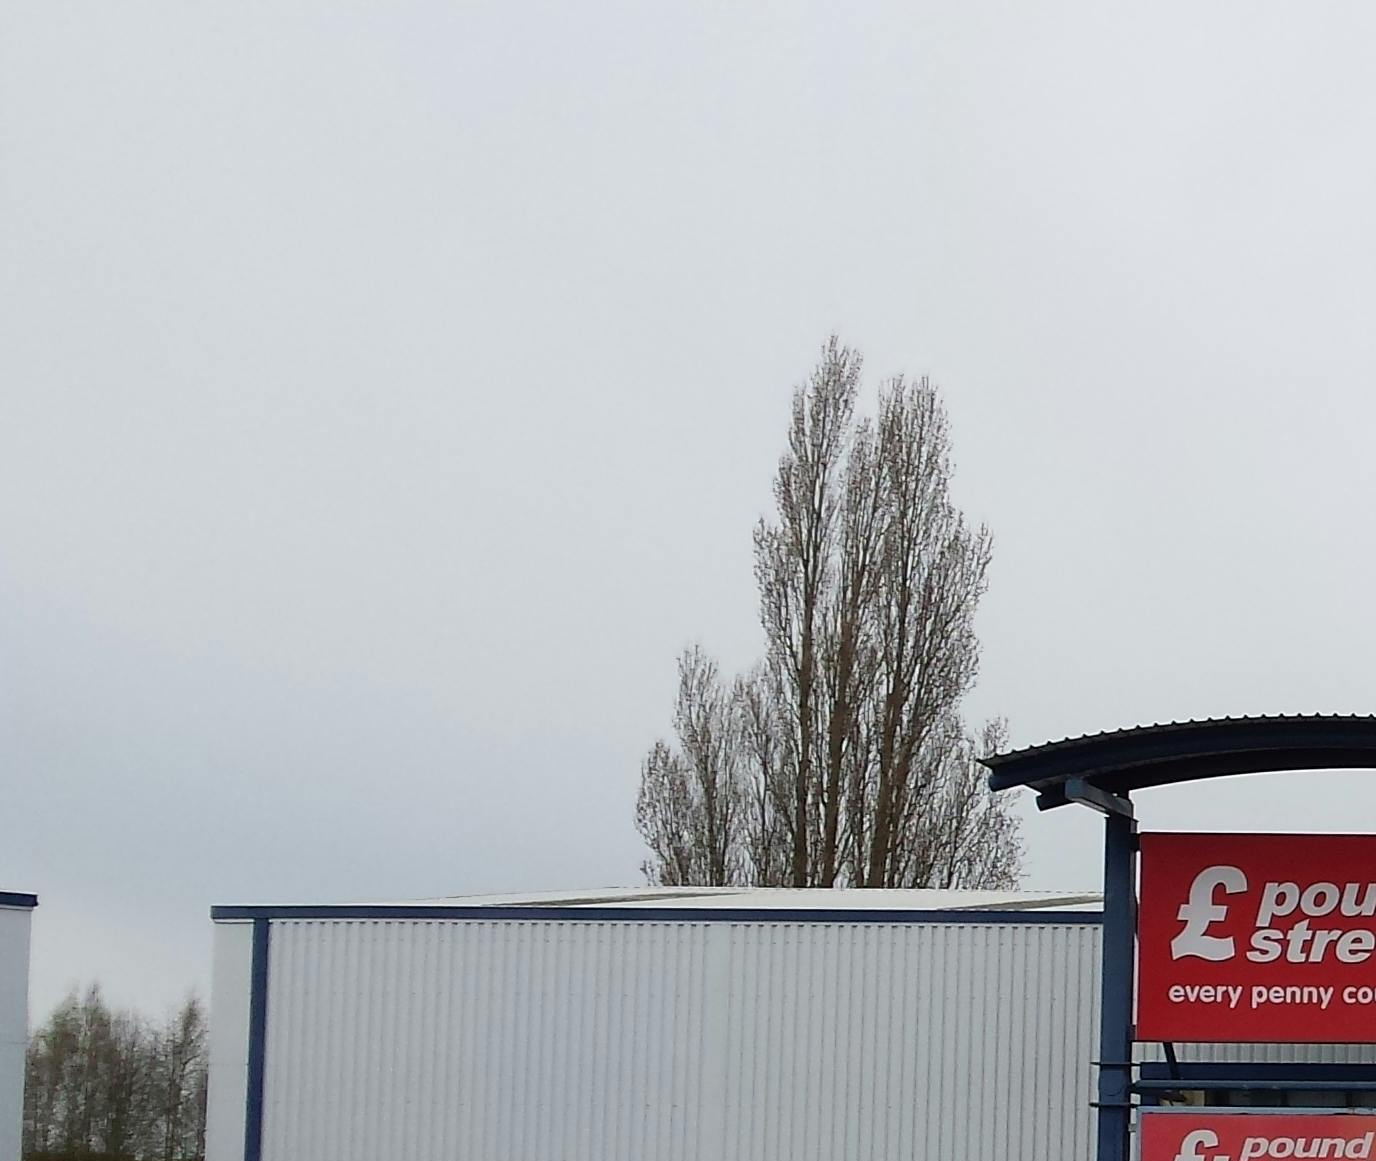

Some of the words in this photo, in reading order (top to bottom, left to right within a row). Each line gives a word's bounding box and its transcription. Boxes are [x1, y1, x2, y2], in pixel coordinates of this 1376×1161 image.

[1169, 865, 1248, 962] £
[1169, 985, 1242, 1008] every
[1251, 985, 1334, 1009] penny
